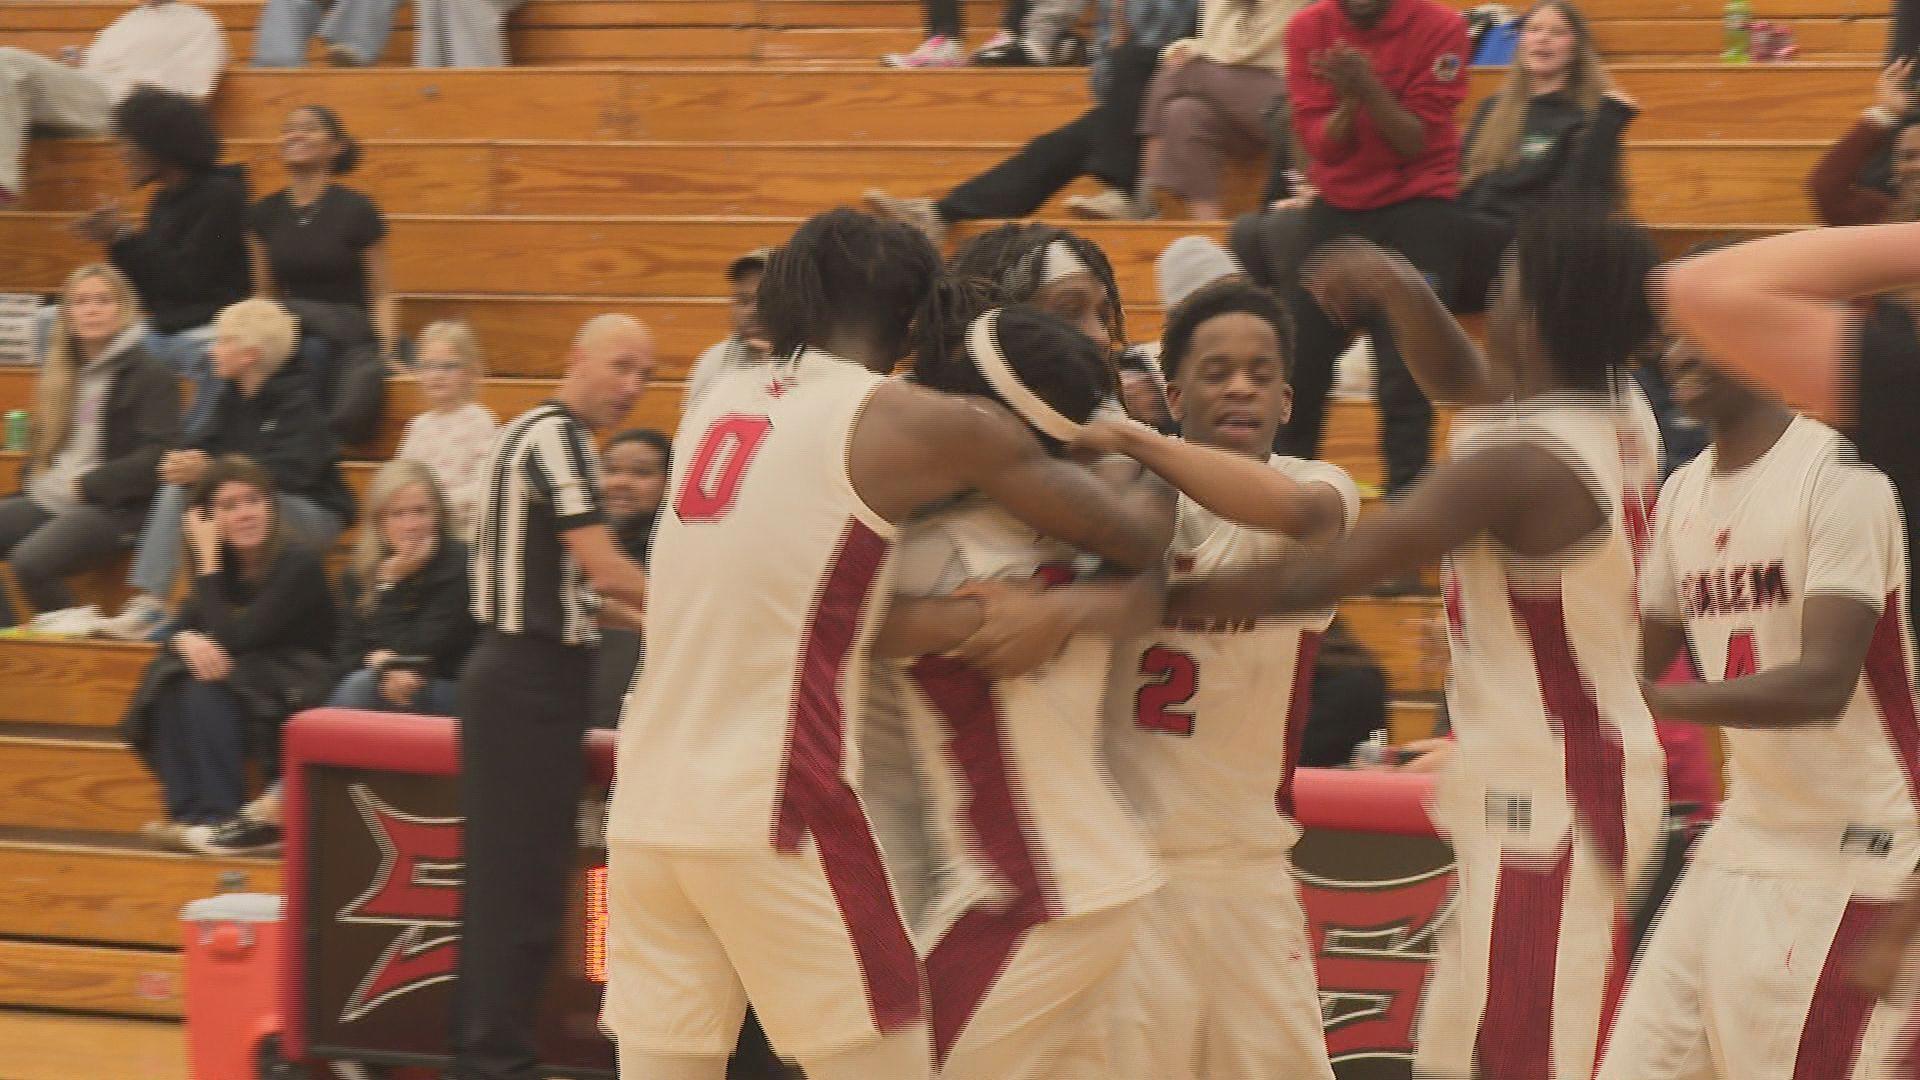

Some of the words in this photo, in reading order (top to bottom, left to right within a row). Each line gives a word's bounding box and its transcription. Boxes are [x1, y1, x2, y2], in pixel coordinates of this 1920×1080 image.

[672, 412, 773, 526] 0
[1681, 561, 1791, 617] SALEM
[1133, 642, 1200, 737] 2
